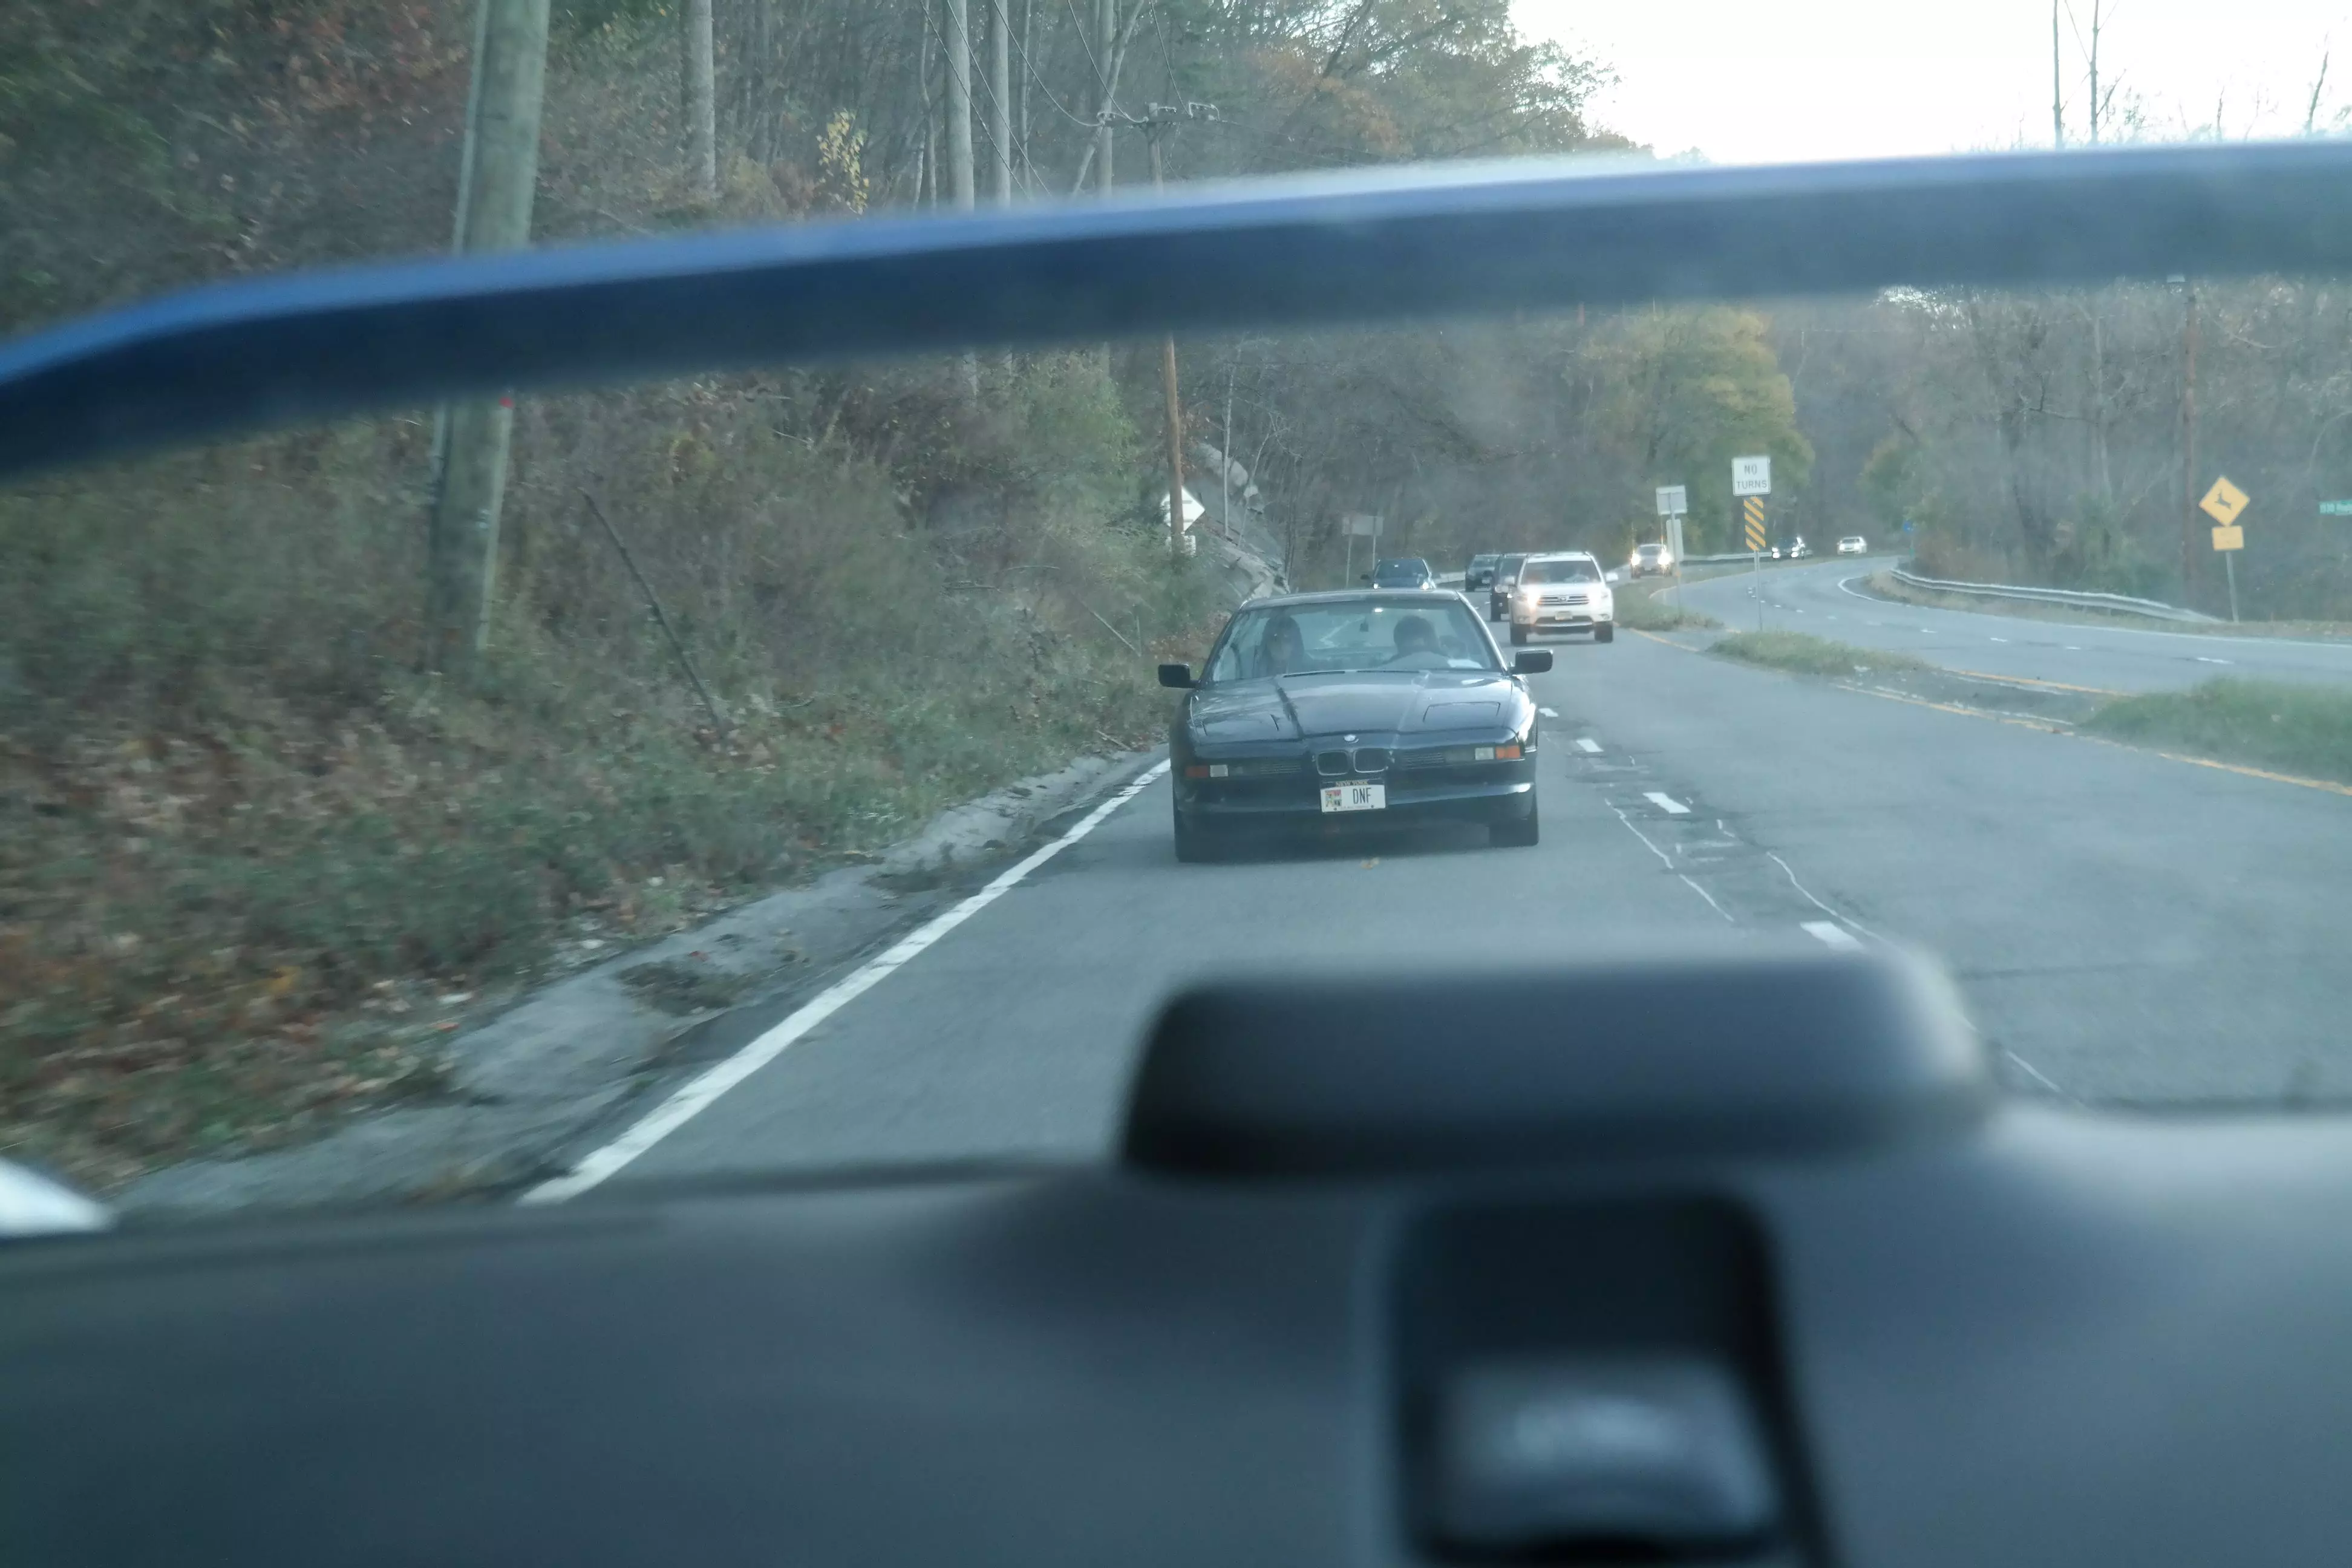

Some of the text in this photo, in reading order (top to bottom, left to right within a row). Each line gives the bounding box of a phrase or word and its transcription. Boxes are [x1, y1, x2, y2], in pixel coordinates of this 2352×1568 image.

[1744, 464, 1757, 475] NO
[1736, 480, 1767, 489] TURNS
[1353, 788, 1371, 805] DNF
